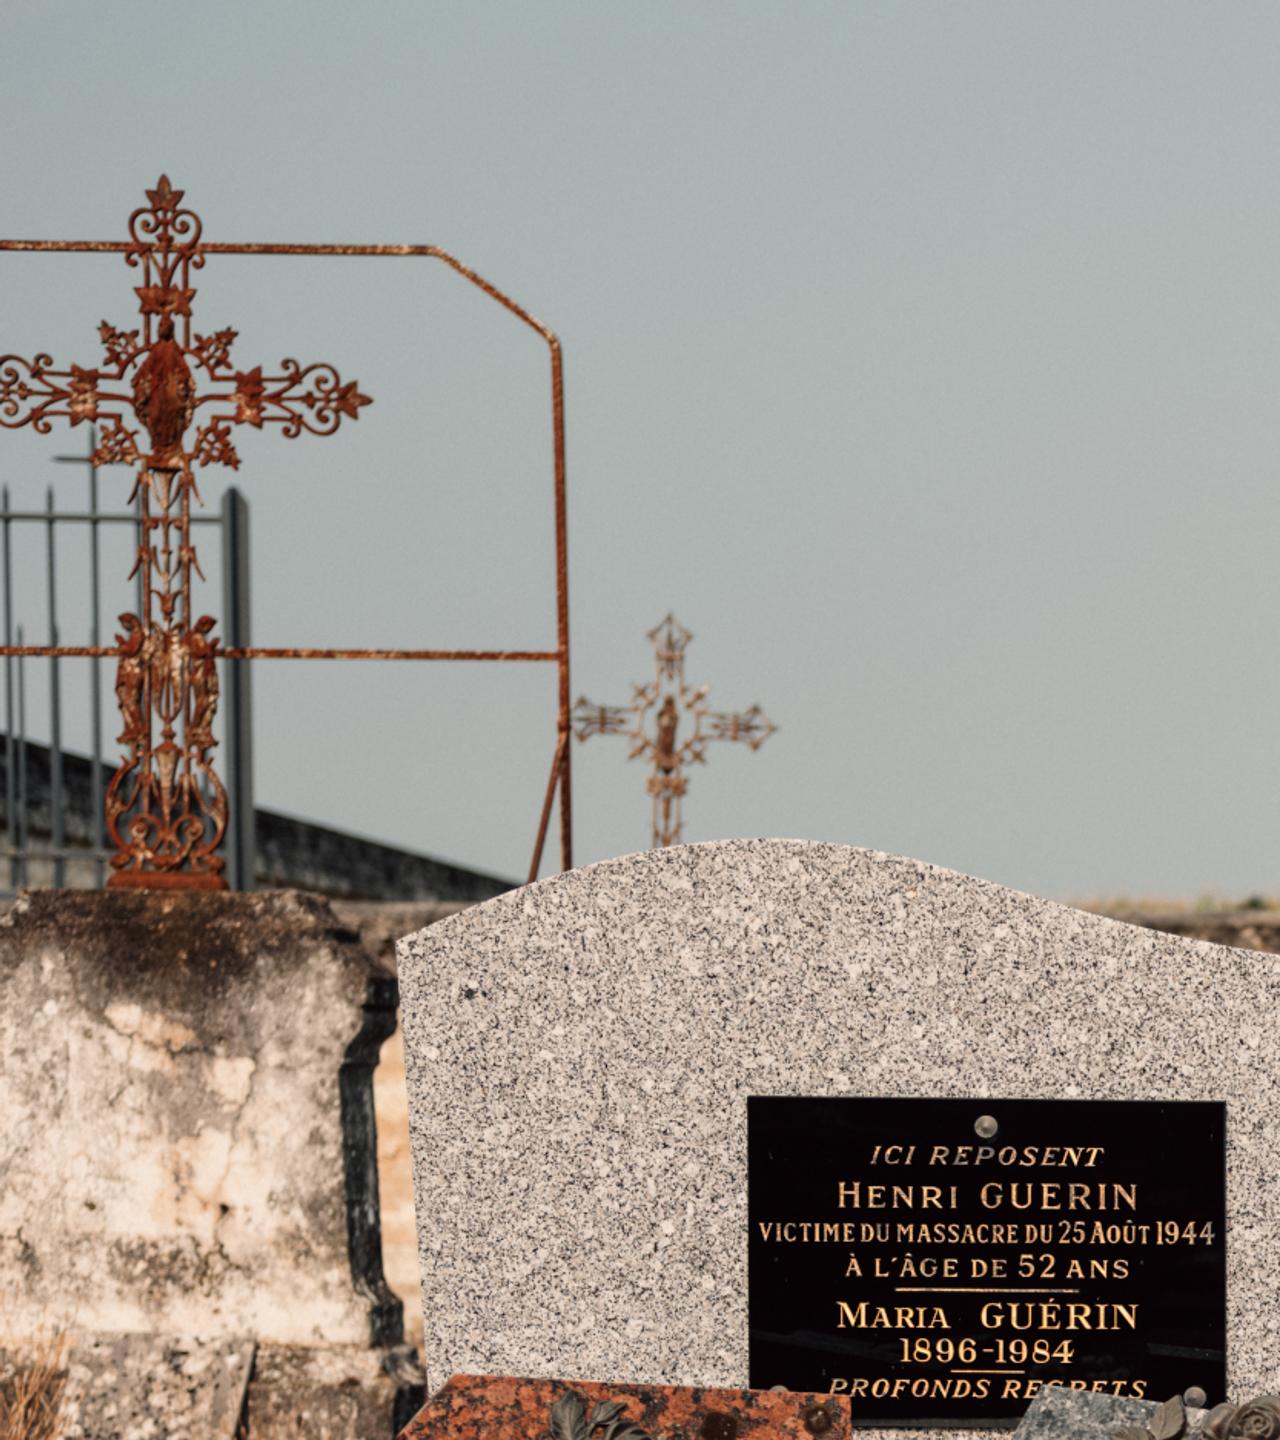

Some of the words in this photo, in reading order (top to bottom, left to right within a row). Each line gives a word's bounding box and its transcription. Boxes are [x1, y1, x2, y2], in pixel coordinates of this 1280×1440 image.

[871, 1146, 915, 1164] ICI
[930, 1146, 1104, 1166] REPOSENT
[839, 1182, 956, 1208] HENRI
[981, 1183, 1136, 1210] GUERIN
[759, 1223, 854, 1242] VICTIME
[861, 1224, 889, 1242] DU
[897, 1223, 1018, 1243] MASSACRE
[1025, 1225, 1052, 1243] DU
[1059, 1220, 1085, 1243] 25
[1157, 1221, 1214, 1244] 1944
[846, 1253, 862, 1276] À
[971, 1259, 1006, 1277] DE
[1019, 1254, 1055, 1278] 52
[1066, 1260, 1128, 1279] ANS
[837, 1302, 950, 1328] MARIA
[981, 1298, 1138, 1329] GUÉRIN
[900, 1338, 1074, 1363] 1896-1984
[829, 1378, 992, 1399] PROFONDS
